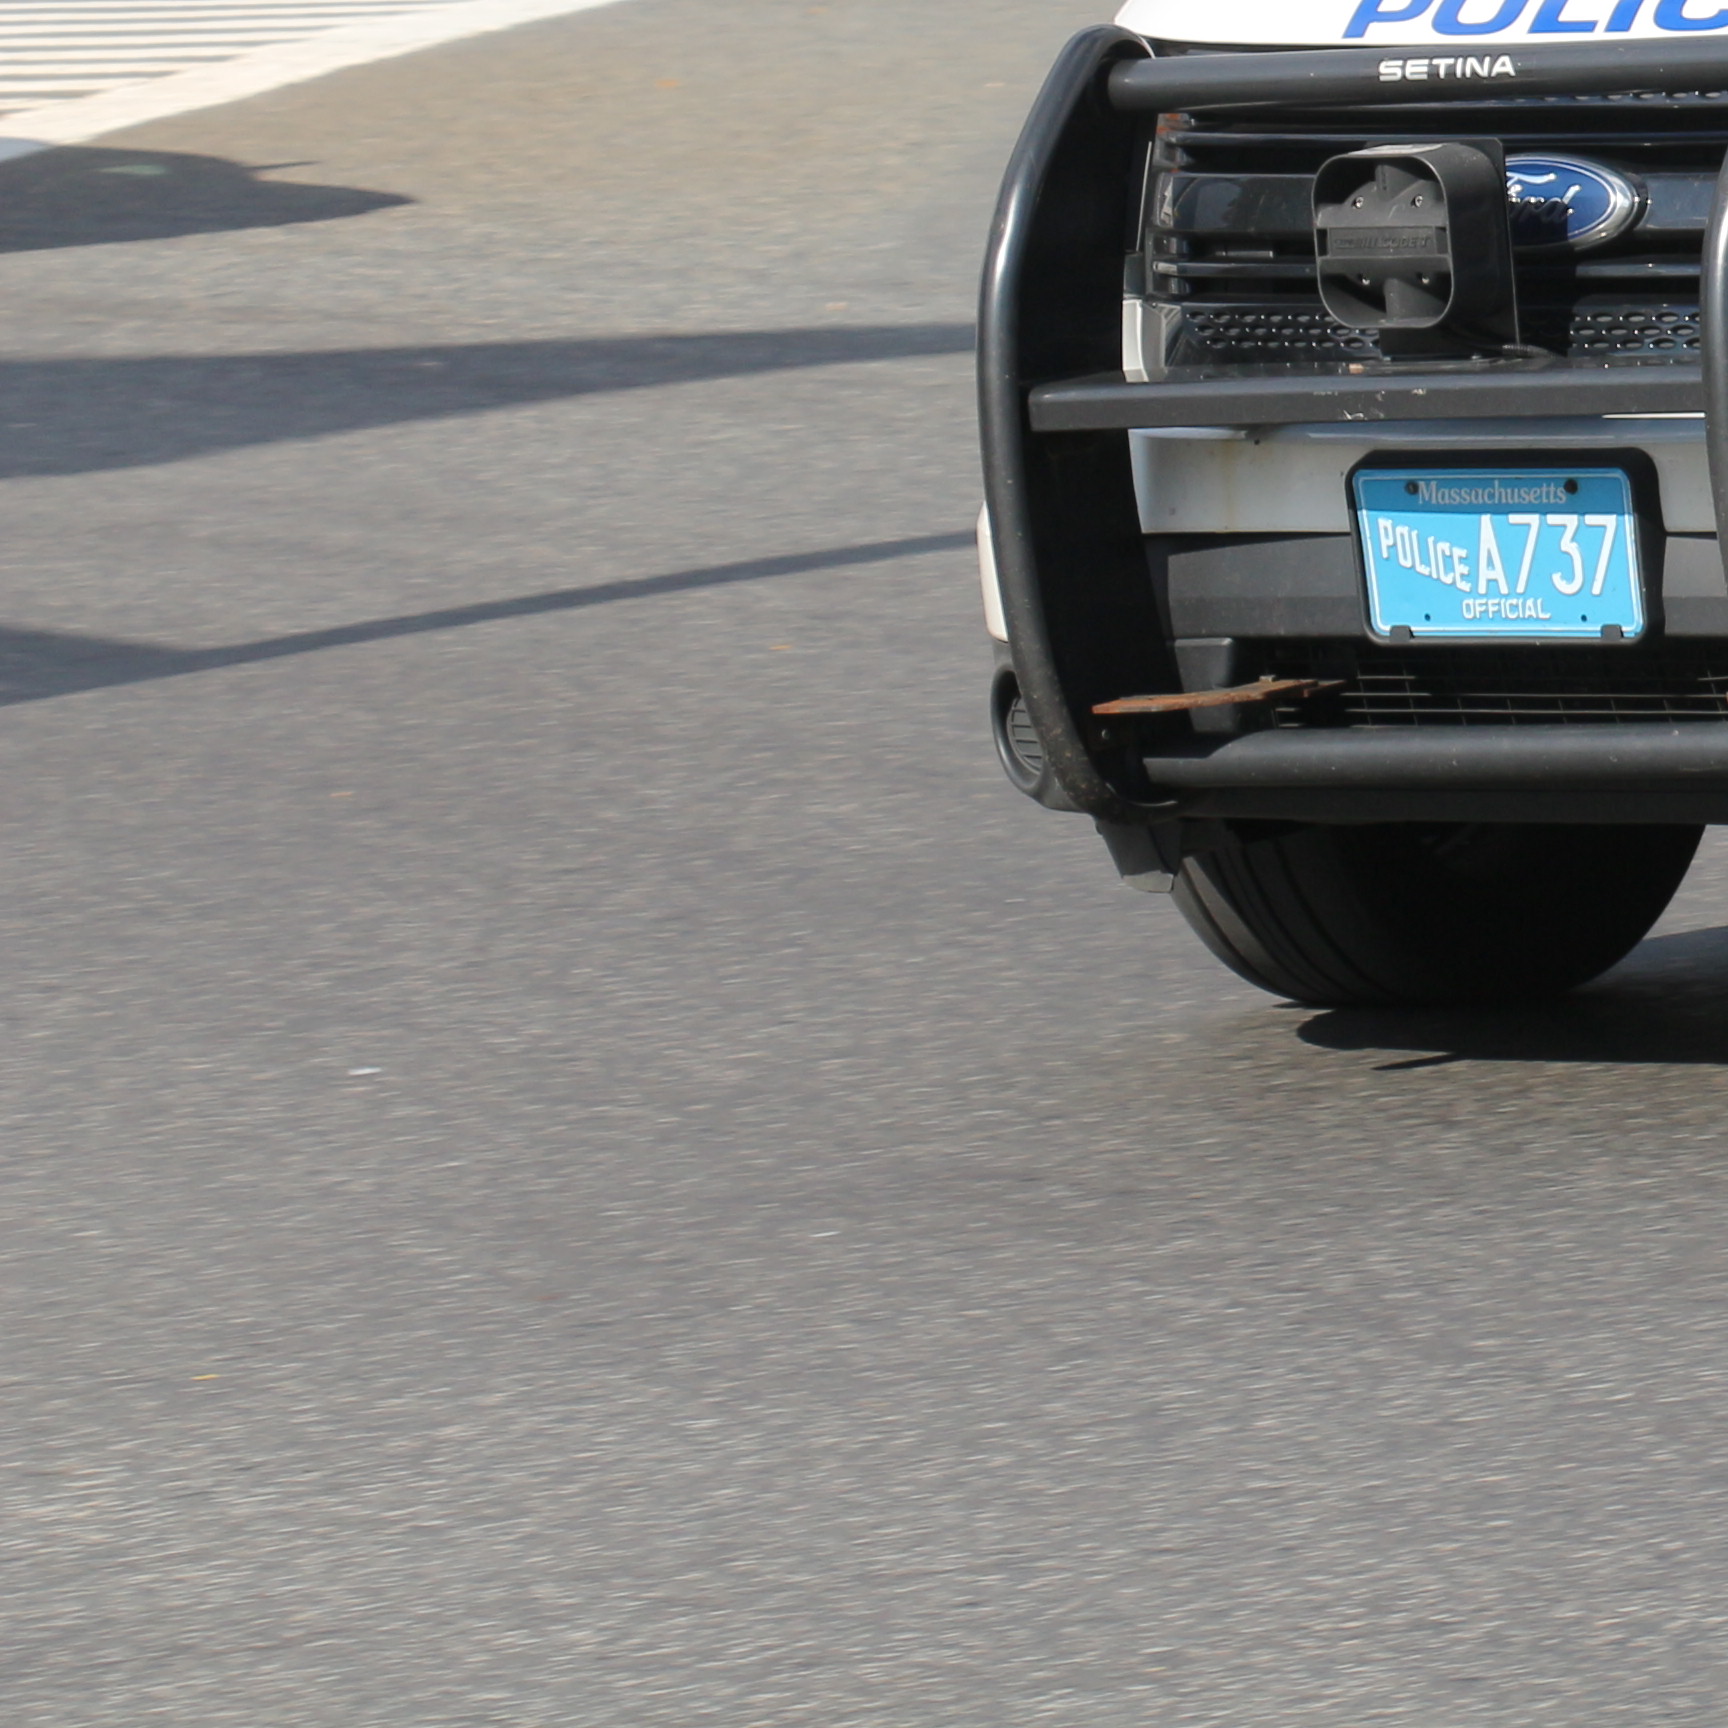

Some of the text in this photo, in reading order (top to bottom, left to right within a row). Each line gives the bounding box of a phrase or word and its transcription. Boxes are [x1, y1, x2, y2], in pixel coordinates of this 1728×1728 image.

[1378, 54, 1516, 83] SETINA
[1418, 480, 1567, 505] Massachusetts
[1377, 513, 1617, 596] POLICE A737
[1462, 598, 1551, 620] OFFICIAL
